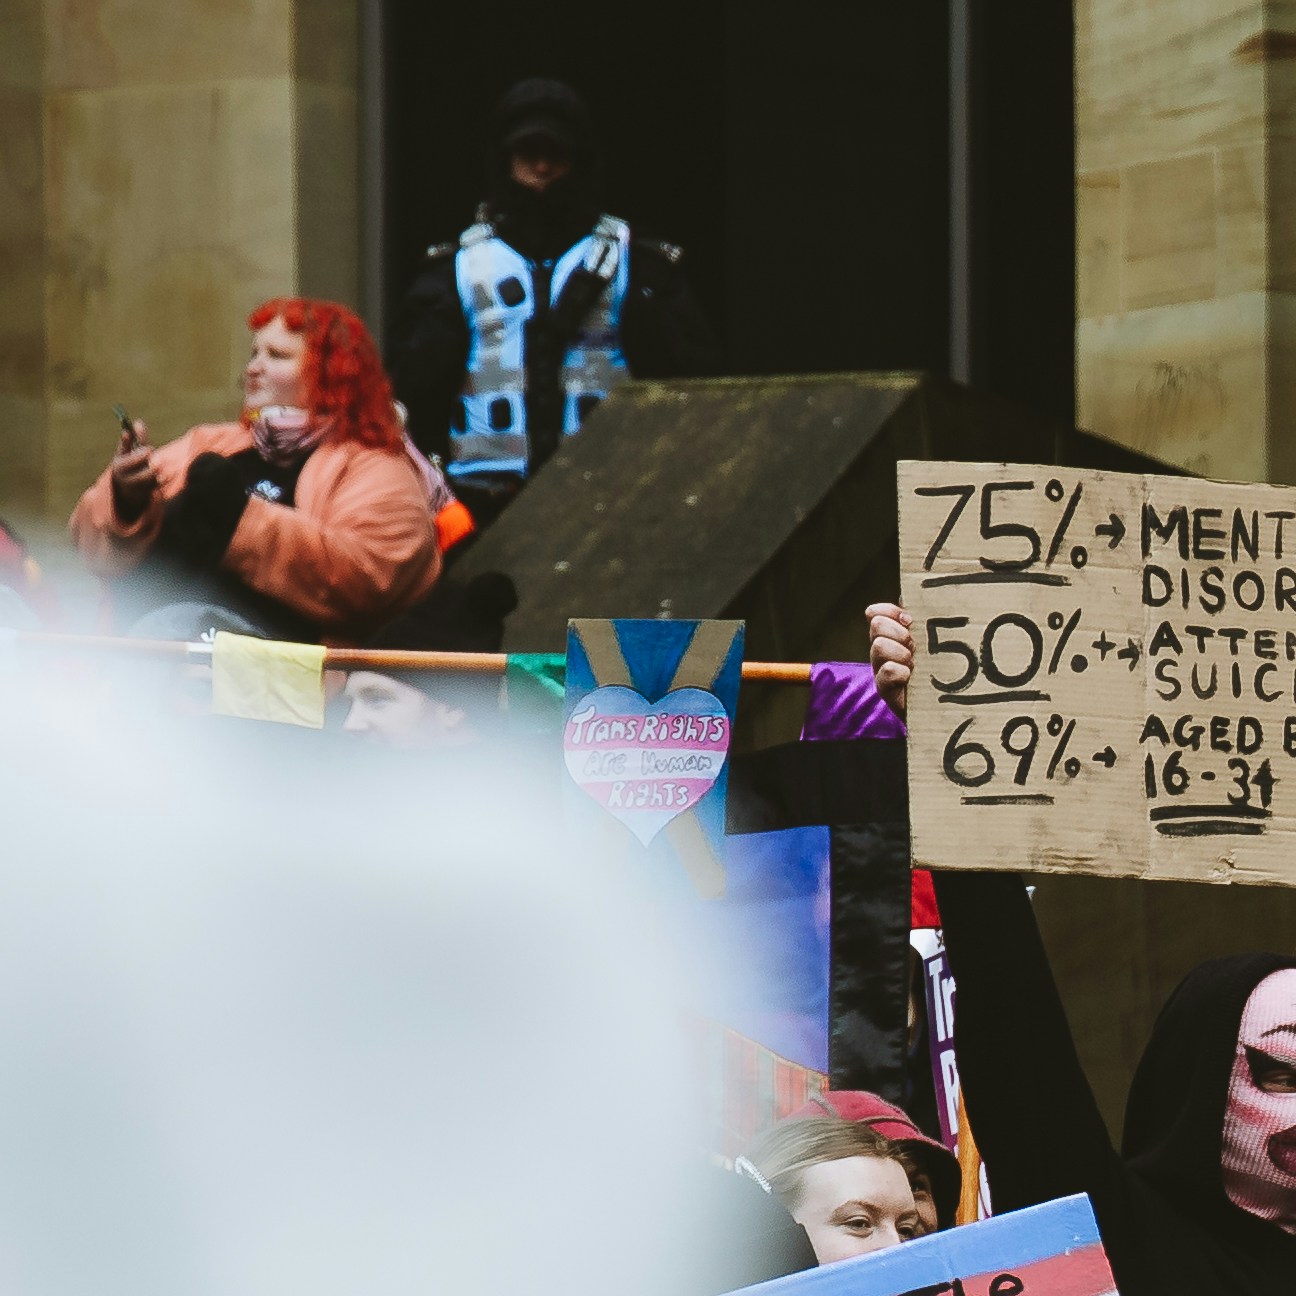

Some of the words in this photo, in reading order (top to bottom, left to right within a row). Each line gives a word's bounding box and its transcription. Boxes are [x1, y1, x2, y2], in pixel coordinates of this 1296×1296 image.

[915, 479, 1087, 571] 75%
[942, 715, 1082, 788] 69%
[1139, 715, 1264, 755] AGED
[1144, 751, 1280, 807] 16-34
